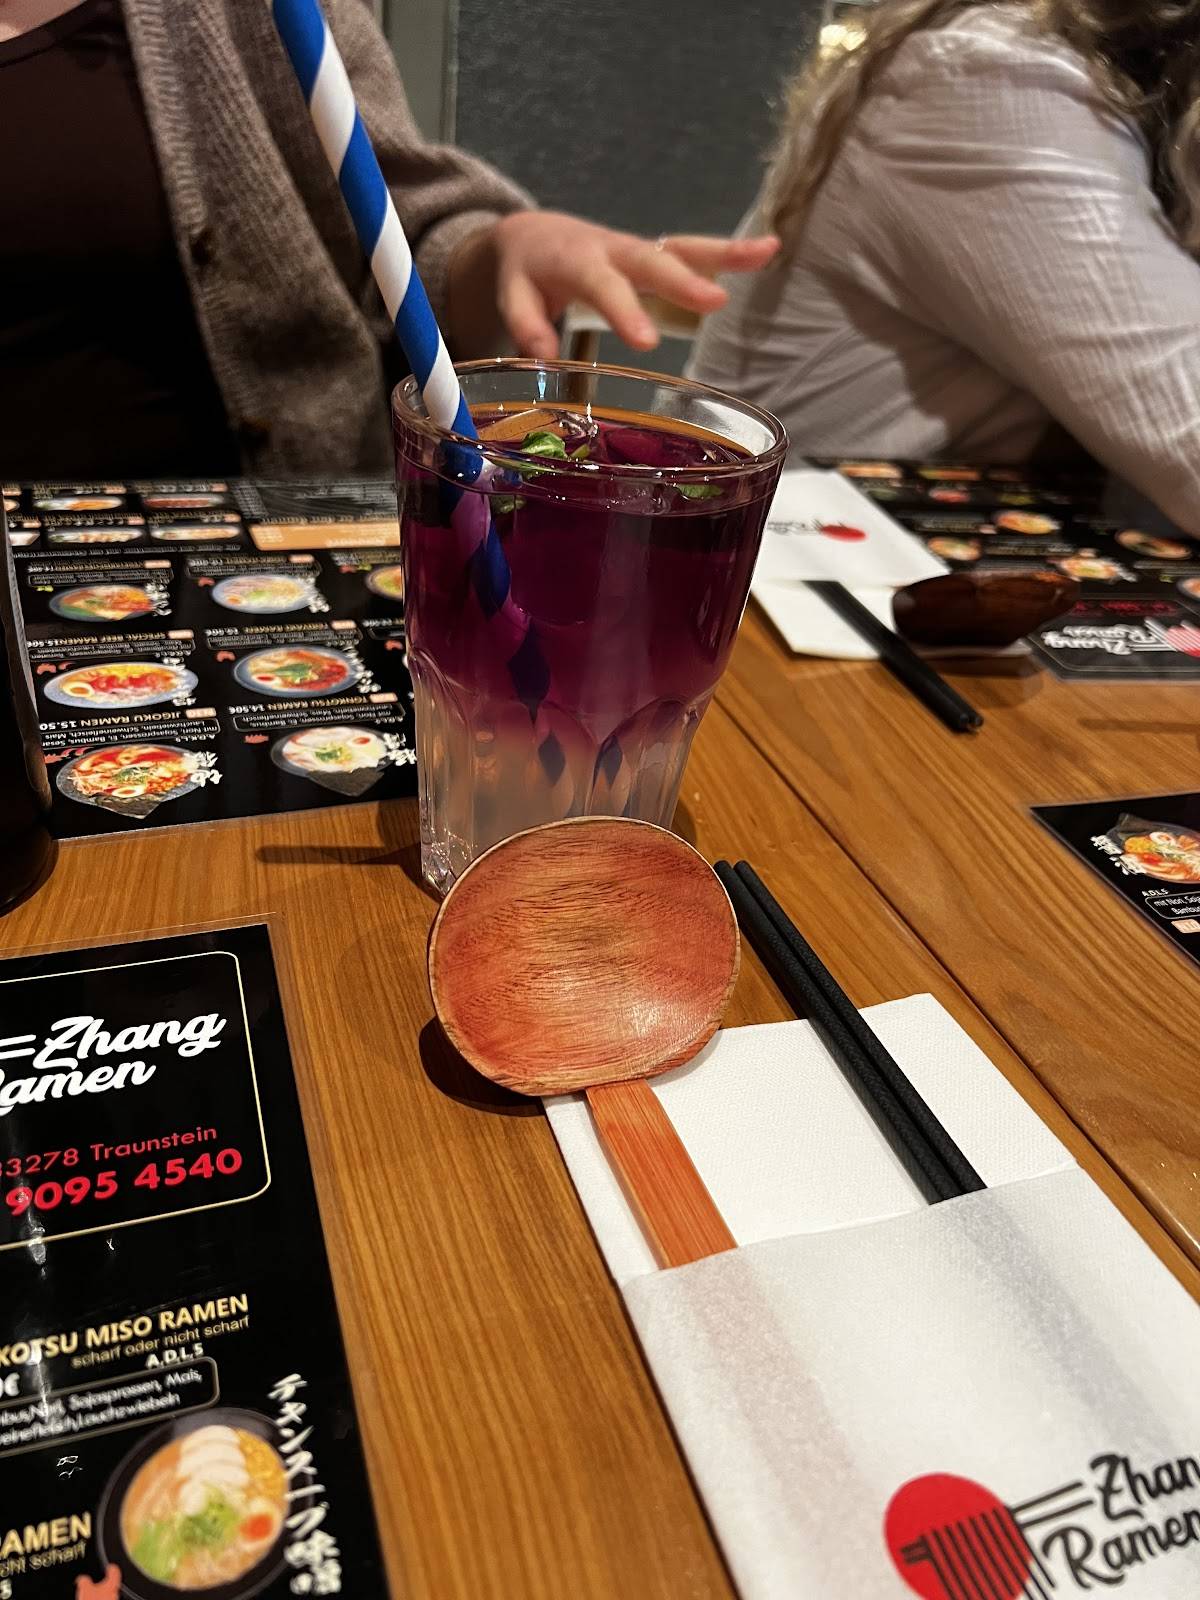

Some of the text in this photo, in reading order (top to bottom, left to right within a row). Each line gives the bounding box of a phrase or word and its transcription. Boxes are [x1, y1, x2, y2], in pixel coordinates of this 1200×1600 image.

[80, 716, 130, 727] RAMEN
[133, 710, 181, 722] JIGOKU
[266, 701, 308, 711] RAMEN
[32, 1013, 227, 1070] Zhang
[90, 1127, 218, 1161] Traunstein
[5, 1148, 243, 1216] 9095 4540
[86, 1314, 153, 1348] MISO
[158, 1293, 249, 1333] RAMEN
[71, 1314, 250, 1369] scharf oder nicht scharf
[163, 1368, 203, 1388] Mais,
